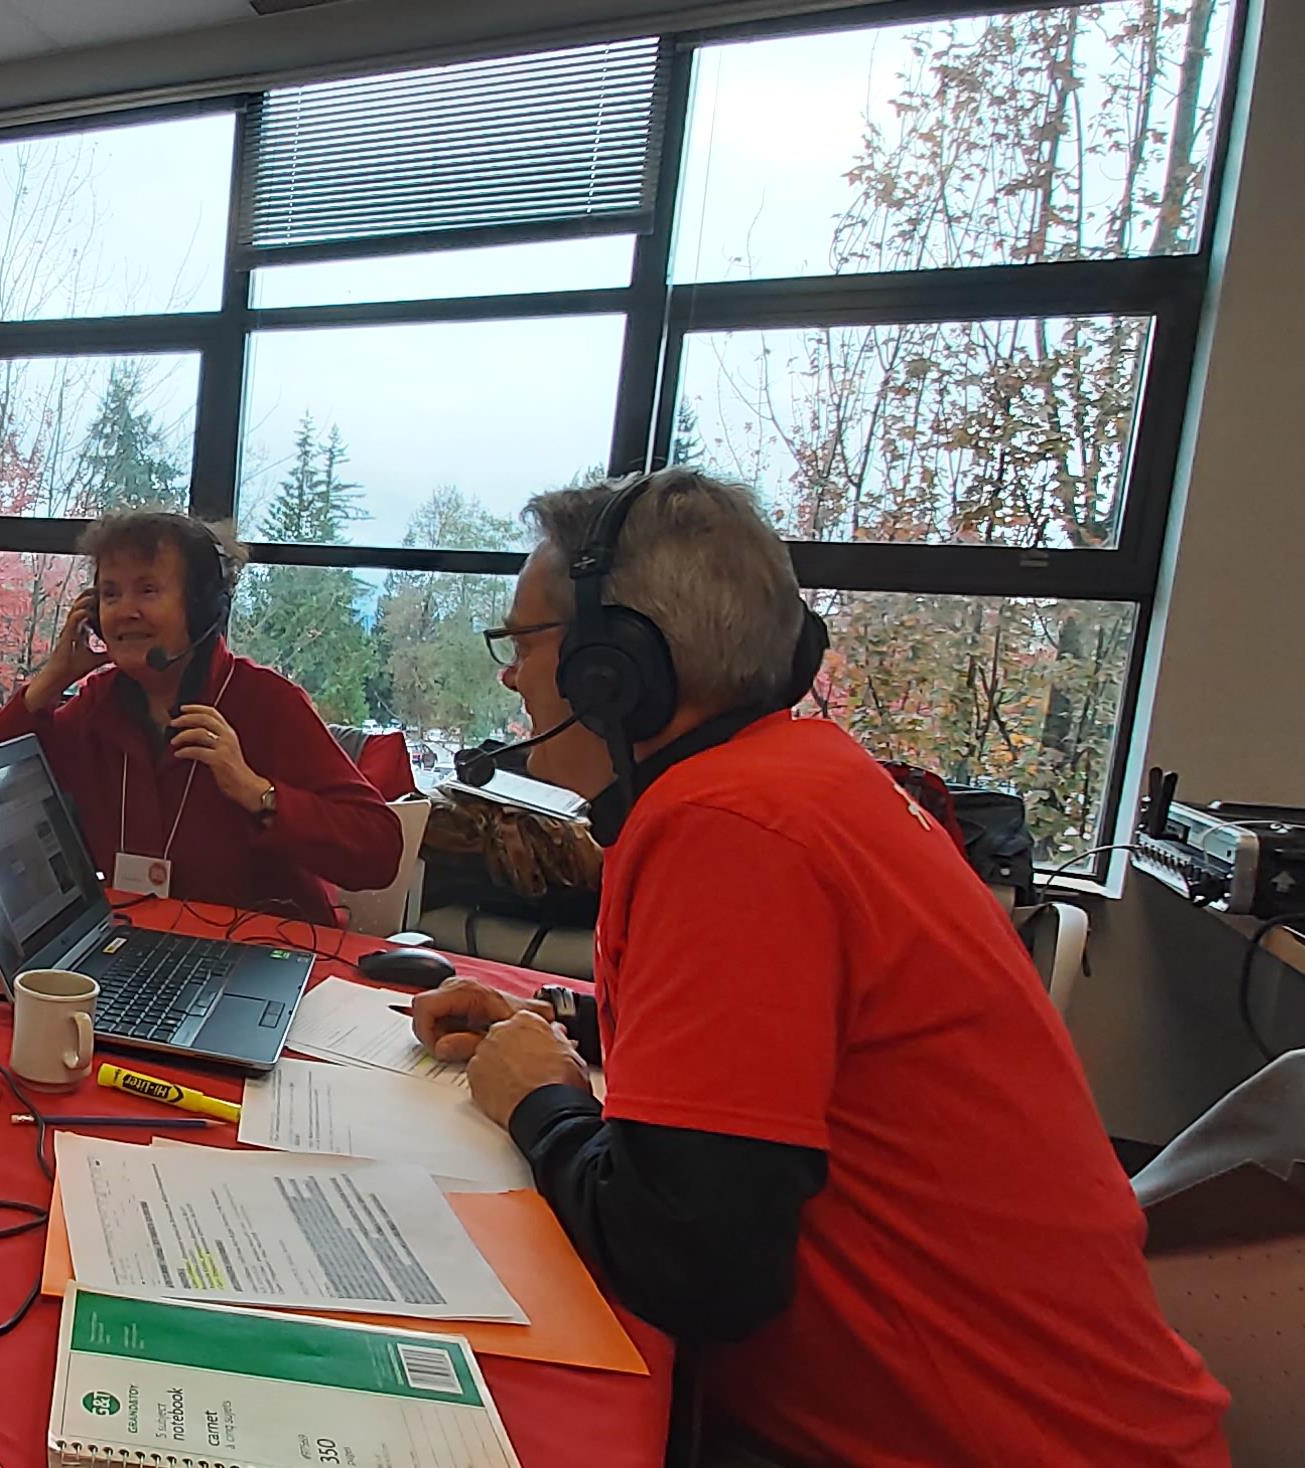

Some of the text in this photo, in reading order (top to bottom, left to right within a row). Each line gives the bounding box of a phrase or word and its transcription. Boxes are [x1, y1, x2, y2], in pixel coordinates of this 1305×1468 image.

[166, 1387, 185, 1441] notebook
[205, 1409, 220, 1446] carnet
[316, 1438, 340, 1465] 350
